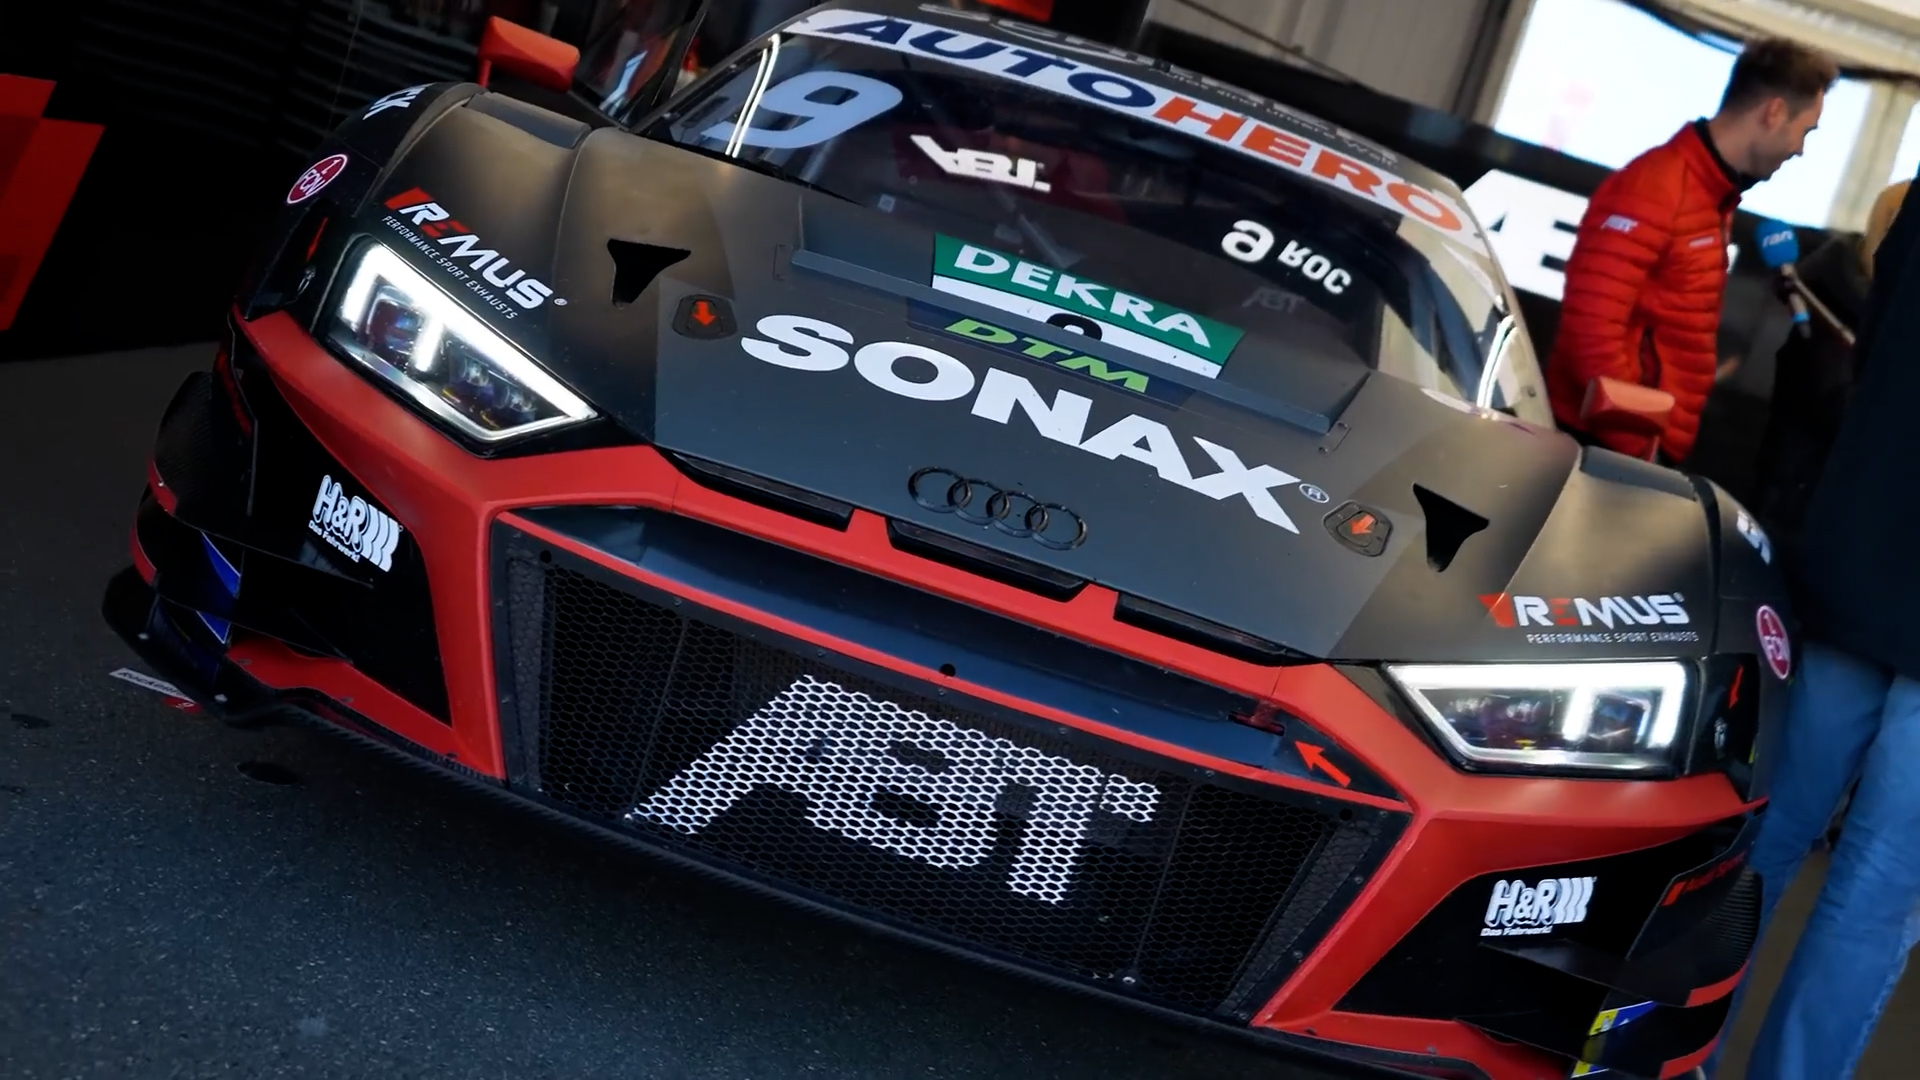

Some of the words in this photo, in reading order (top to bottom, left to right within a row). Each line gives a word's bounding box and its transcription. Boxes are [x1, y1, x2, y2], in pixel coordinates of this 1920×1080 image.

[700, 70, 903, 149] 9
[818, 18, 1462, 231] AUTOHERO
[382, 215, 440, 259] PERFORMANCE
[436, 256, 470, 282] SPORT
[465, 279, 519, 320] EXHAUSTS
[399, 202, 553, 309] REMUS
[953, 243, 1211, 349] DEKRA
[944, 317, 1149, 393] DTM
[741, 314, 1301, 534] SONAX
[312, 474, 370, 553] H&R
[1513, 594, 1690, 630] REMUS
[1526, 632, 1612, 645] PERFORMANCE
[1614, 632, 1649, 644] SPORT
[1649, 630, 1700, 643] EXHAUSTS
[626, 674, 1160, 905] ABT
[1484, 879, 1562, 928] H&R
